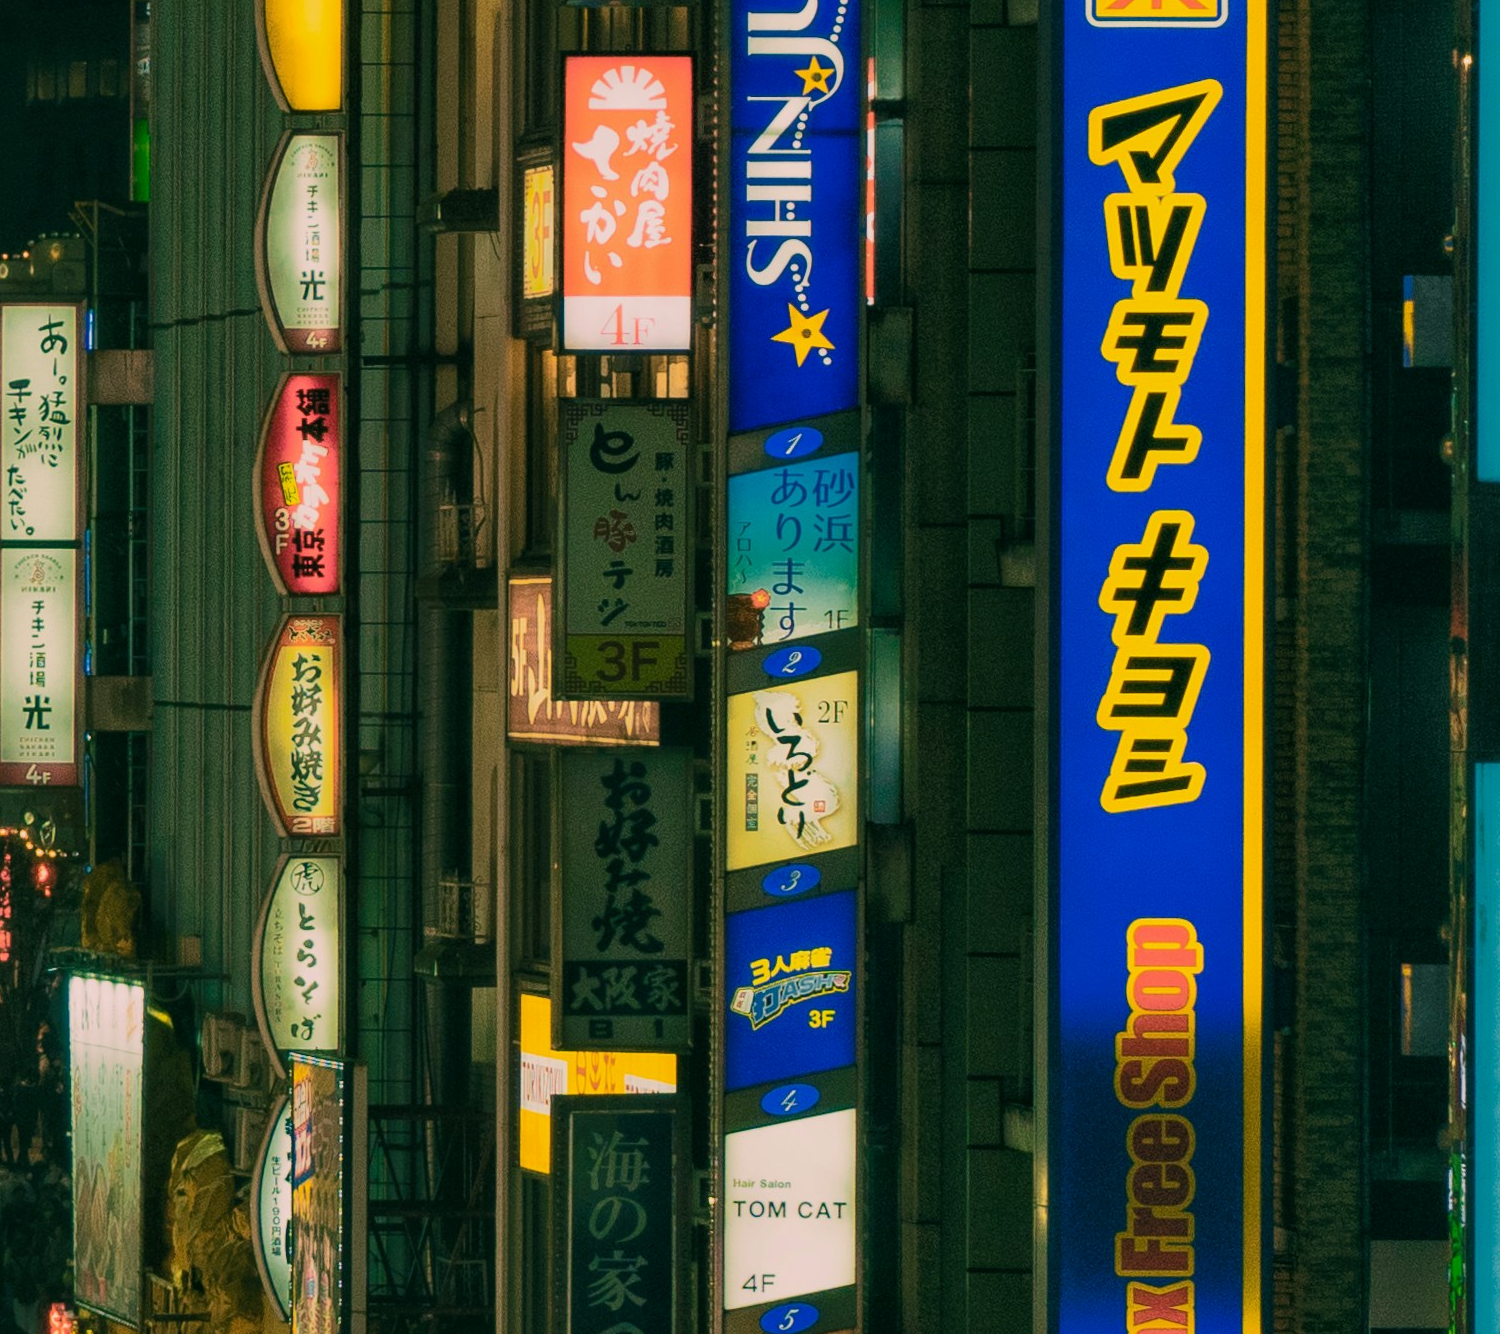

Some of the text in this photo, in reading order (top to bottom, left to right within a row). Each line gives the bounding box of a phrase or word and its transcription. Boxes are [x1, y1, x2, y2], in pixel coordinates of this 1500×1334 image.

[623, 109, 679, 249] 焼肉屋
[305, 329, 329, 350] 4F
[600, 302, 657, 347] 4F
[1088, 79, 1223, 814] マツモト キヨシ
[811, 467, 856, 554] 砂浜
[770, 468, 809, 642] あります
[29, 600, 47, 688] チキン酒場
[595, 639, 660, 684] 3F
[290, 652, 325, 813] お好み焼き
[817, 700, 849, 724] 2F
[24, 764, 53, 786] 4F
[764, 706, 815, 840] いろどり
[290, 902, 322, 1041] とらそば
[749, 946, 834, 985] 3人麻雀
[808, 1009, 836, 1029] 3F
[1114, 917, 1205, 1110] Shop
[732, 1178, 792, 1189] Hair Salon
[732, 1199, 848, 1220] TOM CAT
[1114, 1111, 1196, 1278] Free
[741, 1274, 775, 1294] 4F
